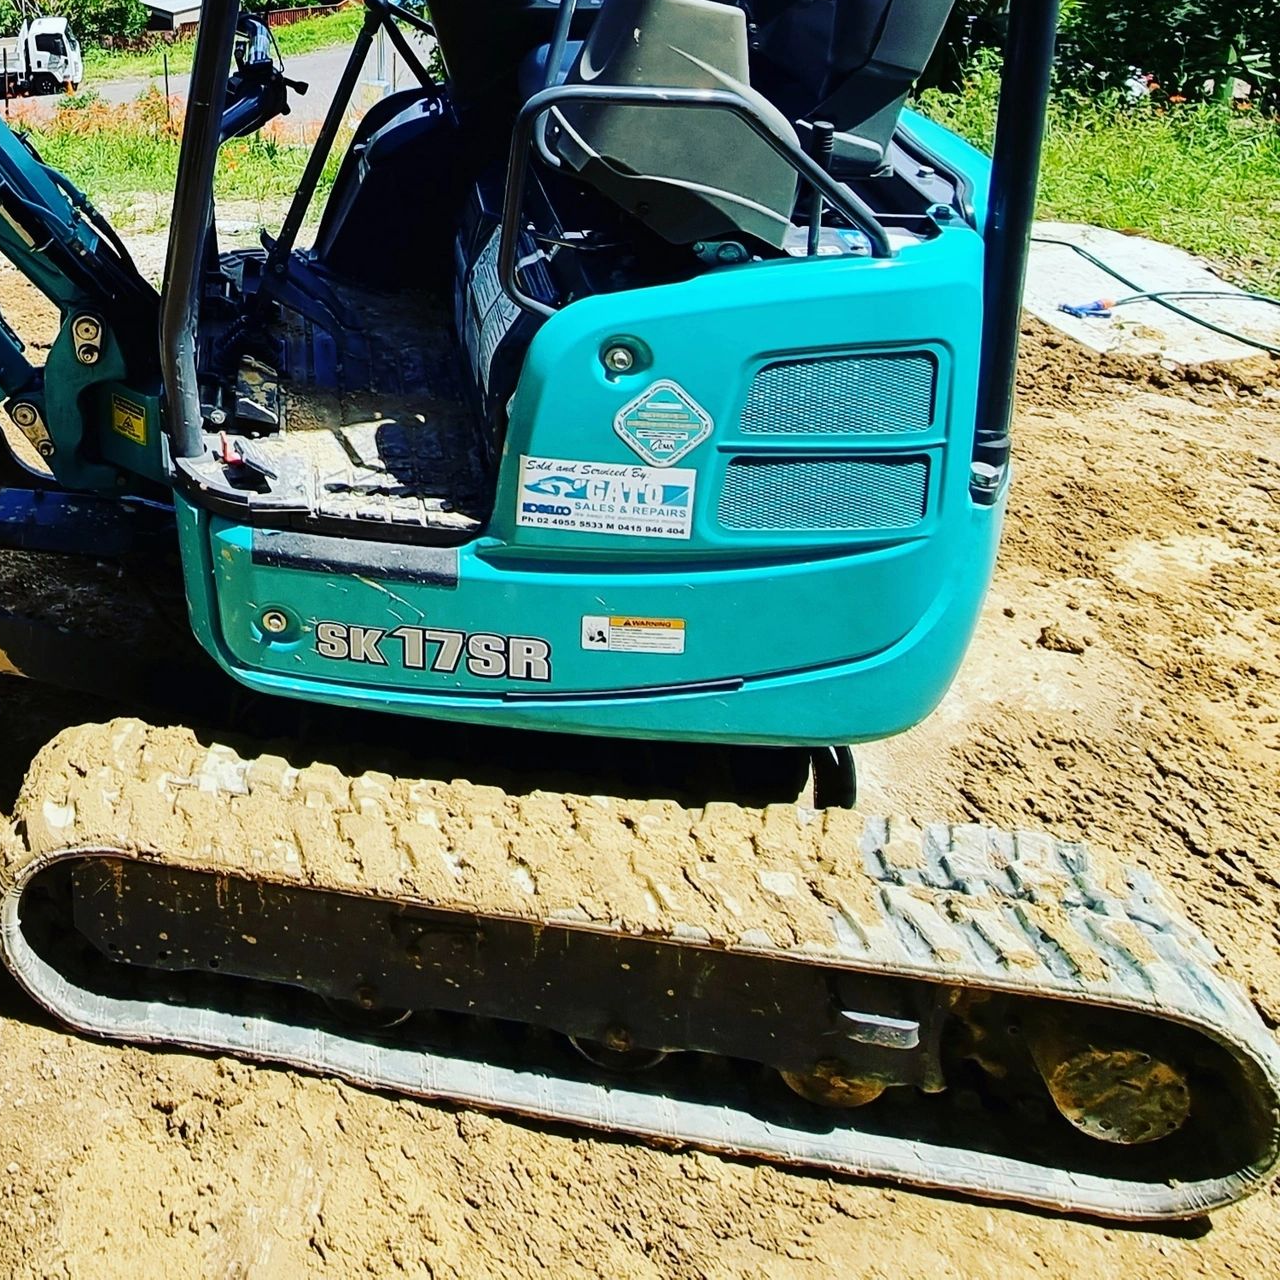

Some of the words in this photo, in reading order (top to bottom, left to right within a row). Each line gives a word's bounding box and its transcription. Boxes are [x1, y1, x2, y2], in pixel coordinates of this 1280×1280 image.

[525, 460, 553, 471] Sold
[556, 464, 577, 473] and
[580, 465, 628, 477] Serviced
[575, 502, 615, 513] SALES
[620, 505, 628, 514] &
[632, 506, 687, 518] REPAIRS
[632, 620, 672, 628] WARNING
